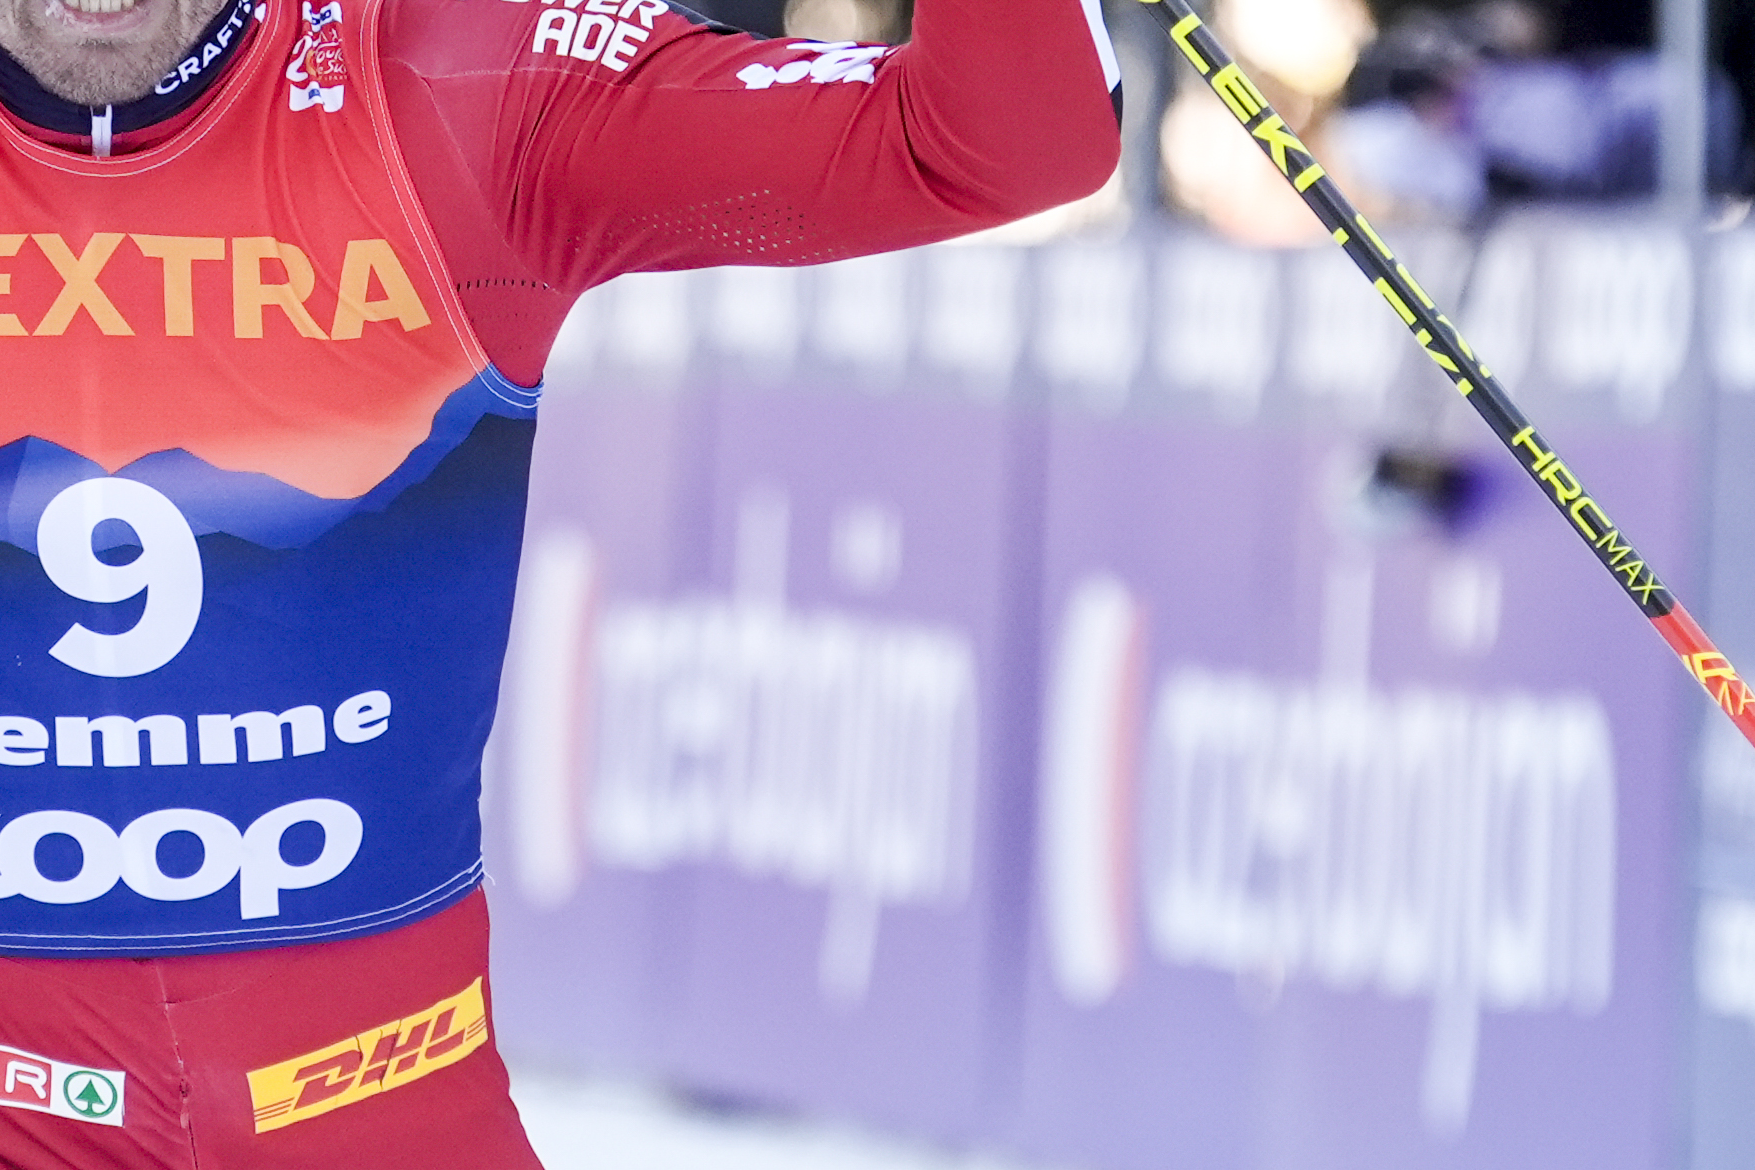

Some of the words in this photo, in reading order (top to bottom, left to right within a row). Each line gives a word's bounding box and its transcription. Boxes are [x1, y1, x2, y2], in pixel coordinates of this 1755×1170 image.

[154, 8, 243, 95] CRAFT
[531, 8, 650, 73] ADE
[1170, 13, 1327, 193] LEKI
[36, 477, 204, 678] 9
[293, 1005, 473, 1112] DHL
